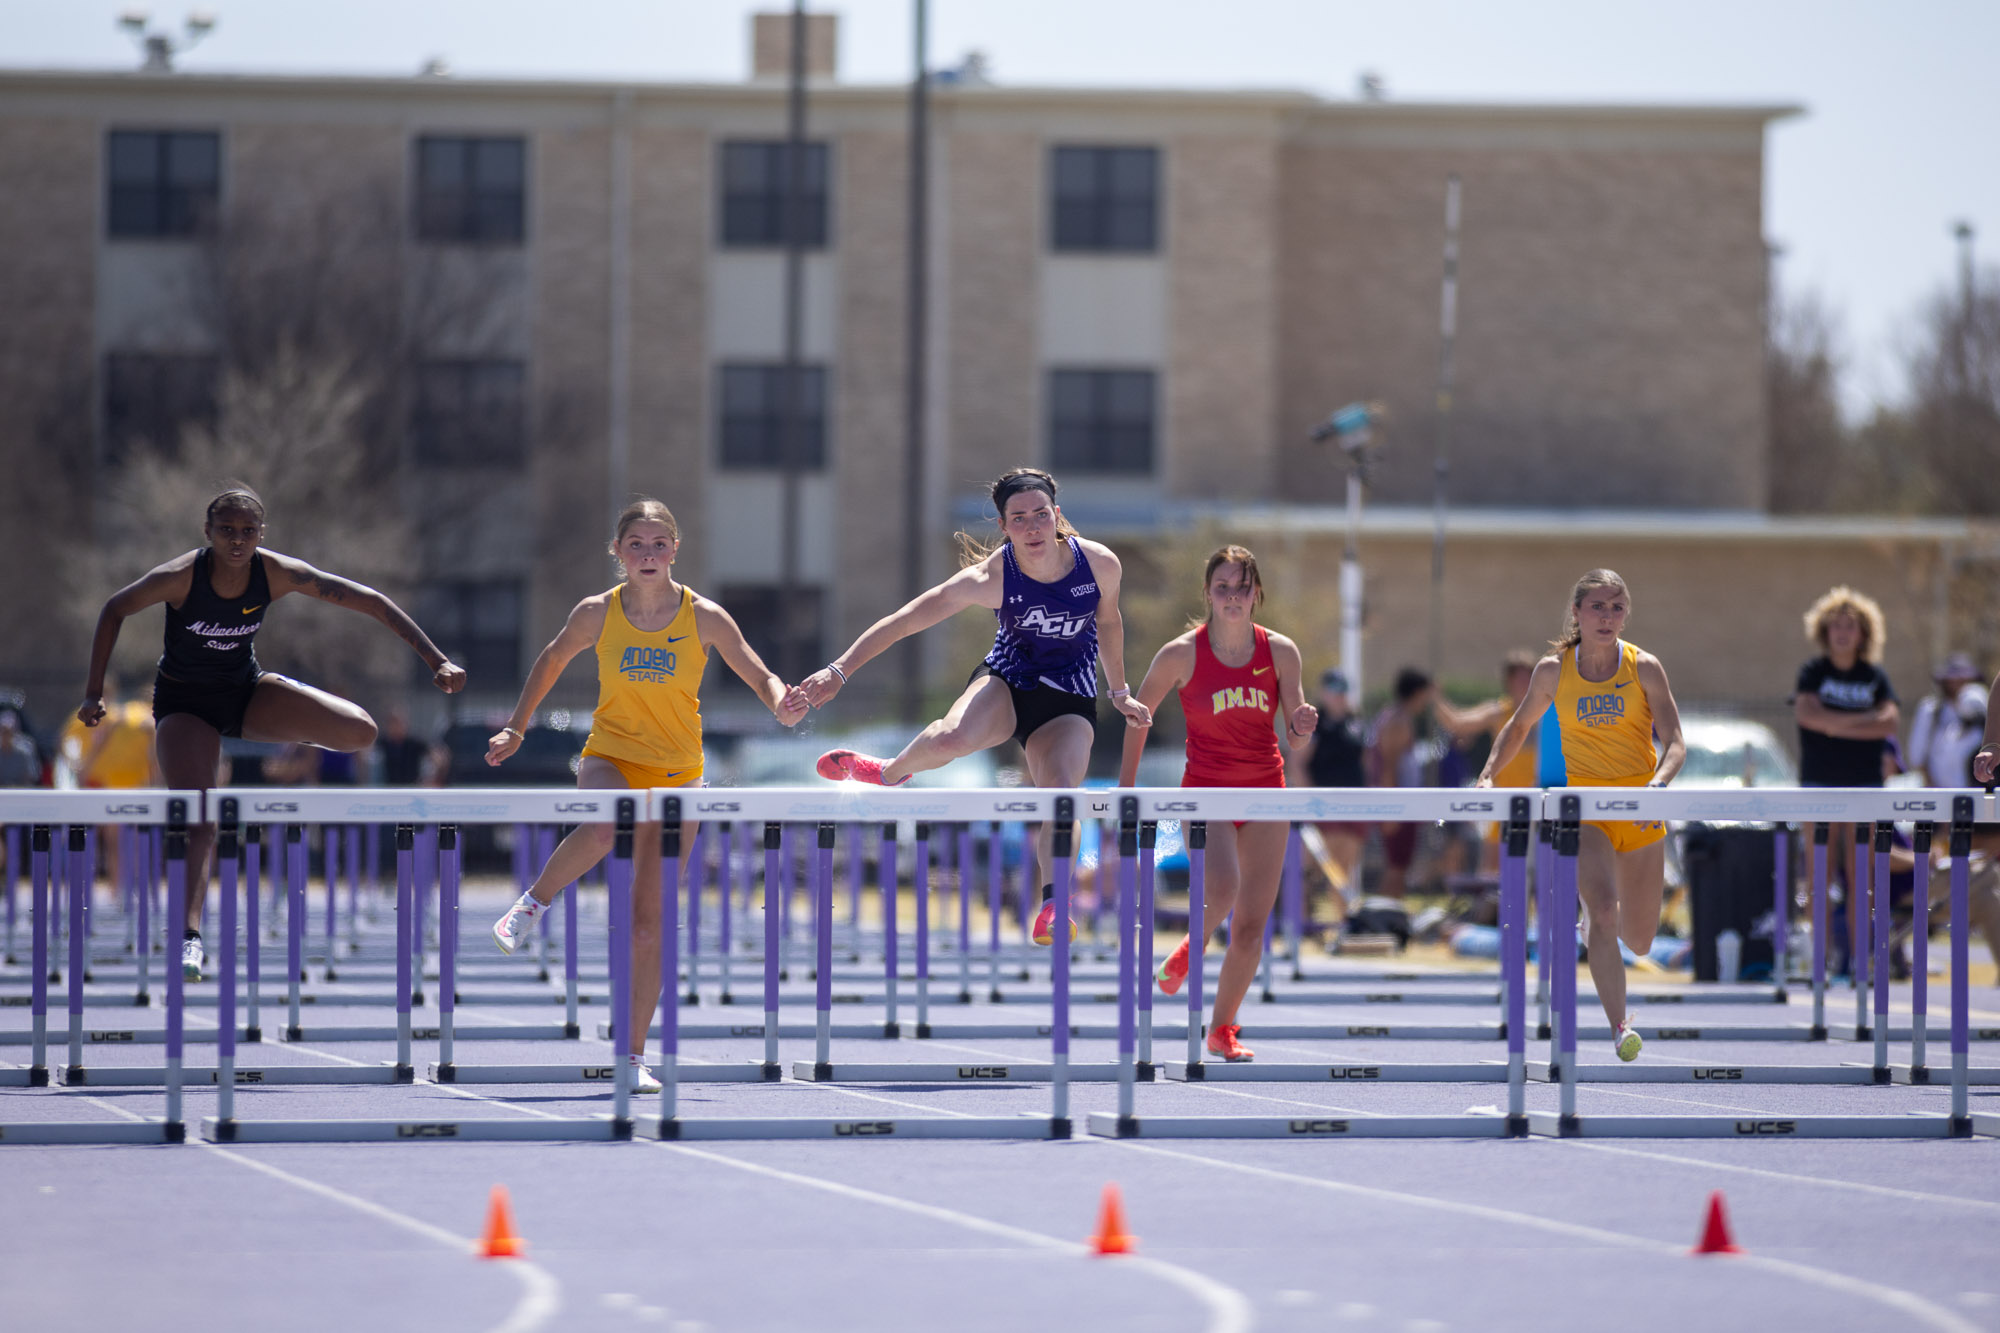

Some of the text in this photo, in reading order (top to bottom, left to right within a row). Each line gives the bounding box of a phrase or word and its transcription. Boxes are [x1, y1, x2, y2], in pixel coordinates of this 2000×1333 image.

[1071, 583, 1096, 597] WAC
[1021, 609, 1086, 637] ACU
[619, 646, 677, 671] Angelo
[628, 671, 668, 684] STATE
[1212, 686, 1270, 715] NMJC
[1577, 693, 1625, 717] Angelo
[1585, 715, 1618, 727] STATE
[105, 804, 150, 814] UCS
[254, 802, 299, 812] UCS
[555, 802, 599, 812] UCS
[697, 802, 741, 812] UCS
[994, 802, 1038, 812] UCS
[1154, 802, 1198, 811] UCS
[1450, 801, 1494, 812] UCS
[1596, 800, 1639, 811] UCS
[1893, 801, 1936, 811] UCS
[91, 1032, 133, 1042] UCS
[959, 1067, 1007, 1078] UCS
[1331, 1068, 1379, 1079] UCS
[1694, 1069, 1742, 1080] UCS
[398, 1125, 457, 1137] UCS
[835, 1123, 893, 1135] UCS
[1290, 1121, 1348, 1133] UCS
[1736, 1121, 1795, 1134] UCS
